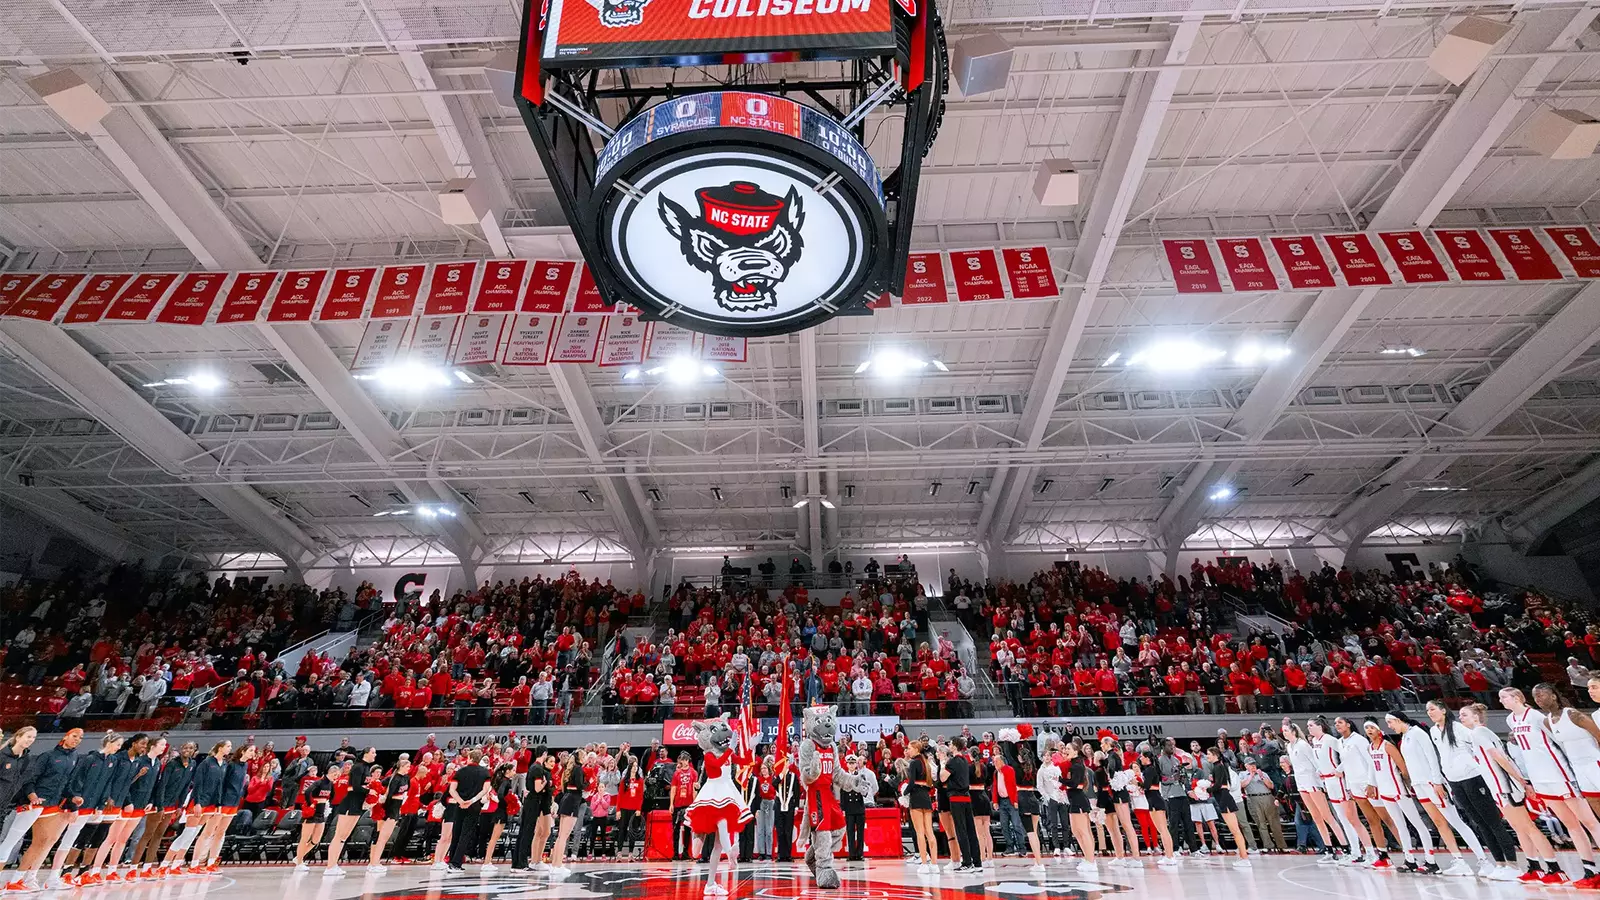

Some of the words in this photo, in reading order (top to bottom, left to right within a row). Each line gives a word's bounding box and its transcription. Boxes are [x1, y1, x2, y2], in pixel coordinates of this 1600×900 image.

[688, 0, 870, 19] COLISEUM
[676, 100, 696, 118] 0
[746, 98, 768, 116] 0
[656, 116, 716, 136] SYRACUSE
[730, 117, 746, 126] NC
[748, 118, 784, 131] STATE
[818, 124, 866, 170] 10:00
[711, 208, 729, 224] NC
[732, 214, 770, 228] STATE
[840, 724, 865, 734] UNC
[1106, 725, 1163, 736] COLISEUM
[460, 736, 508, 745] VALVNO
[1517, 734, 1531, 750] 11
